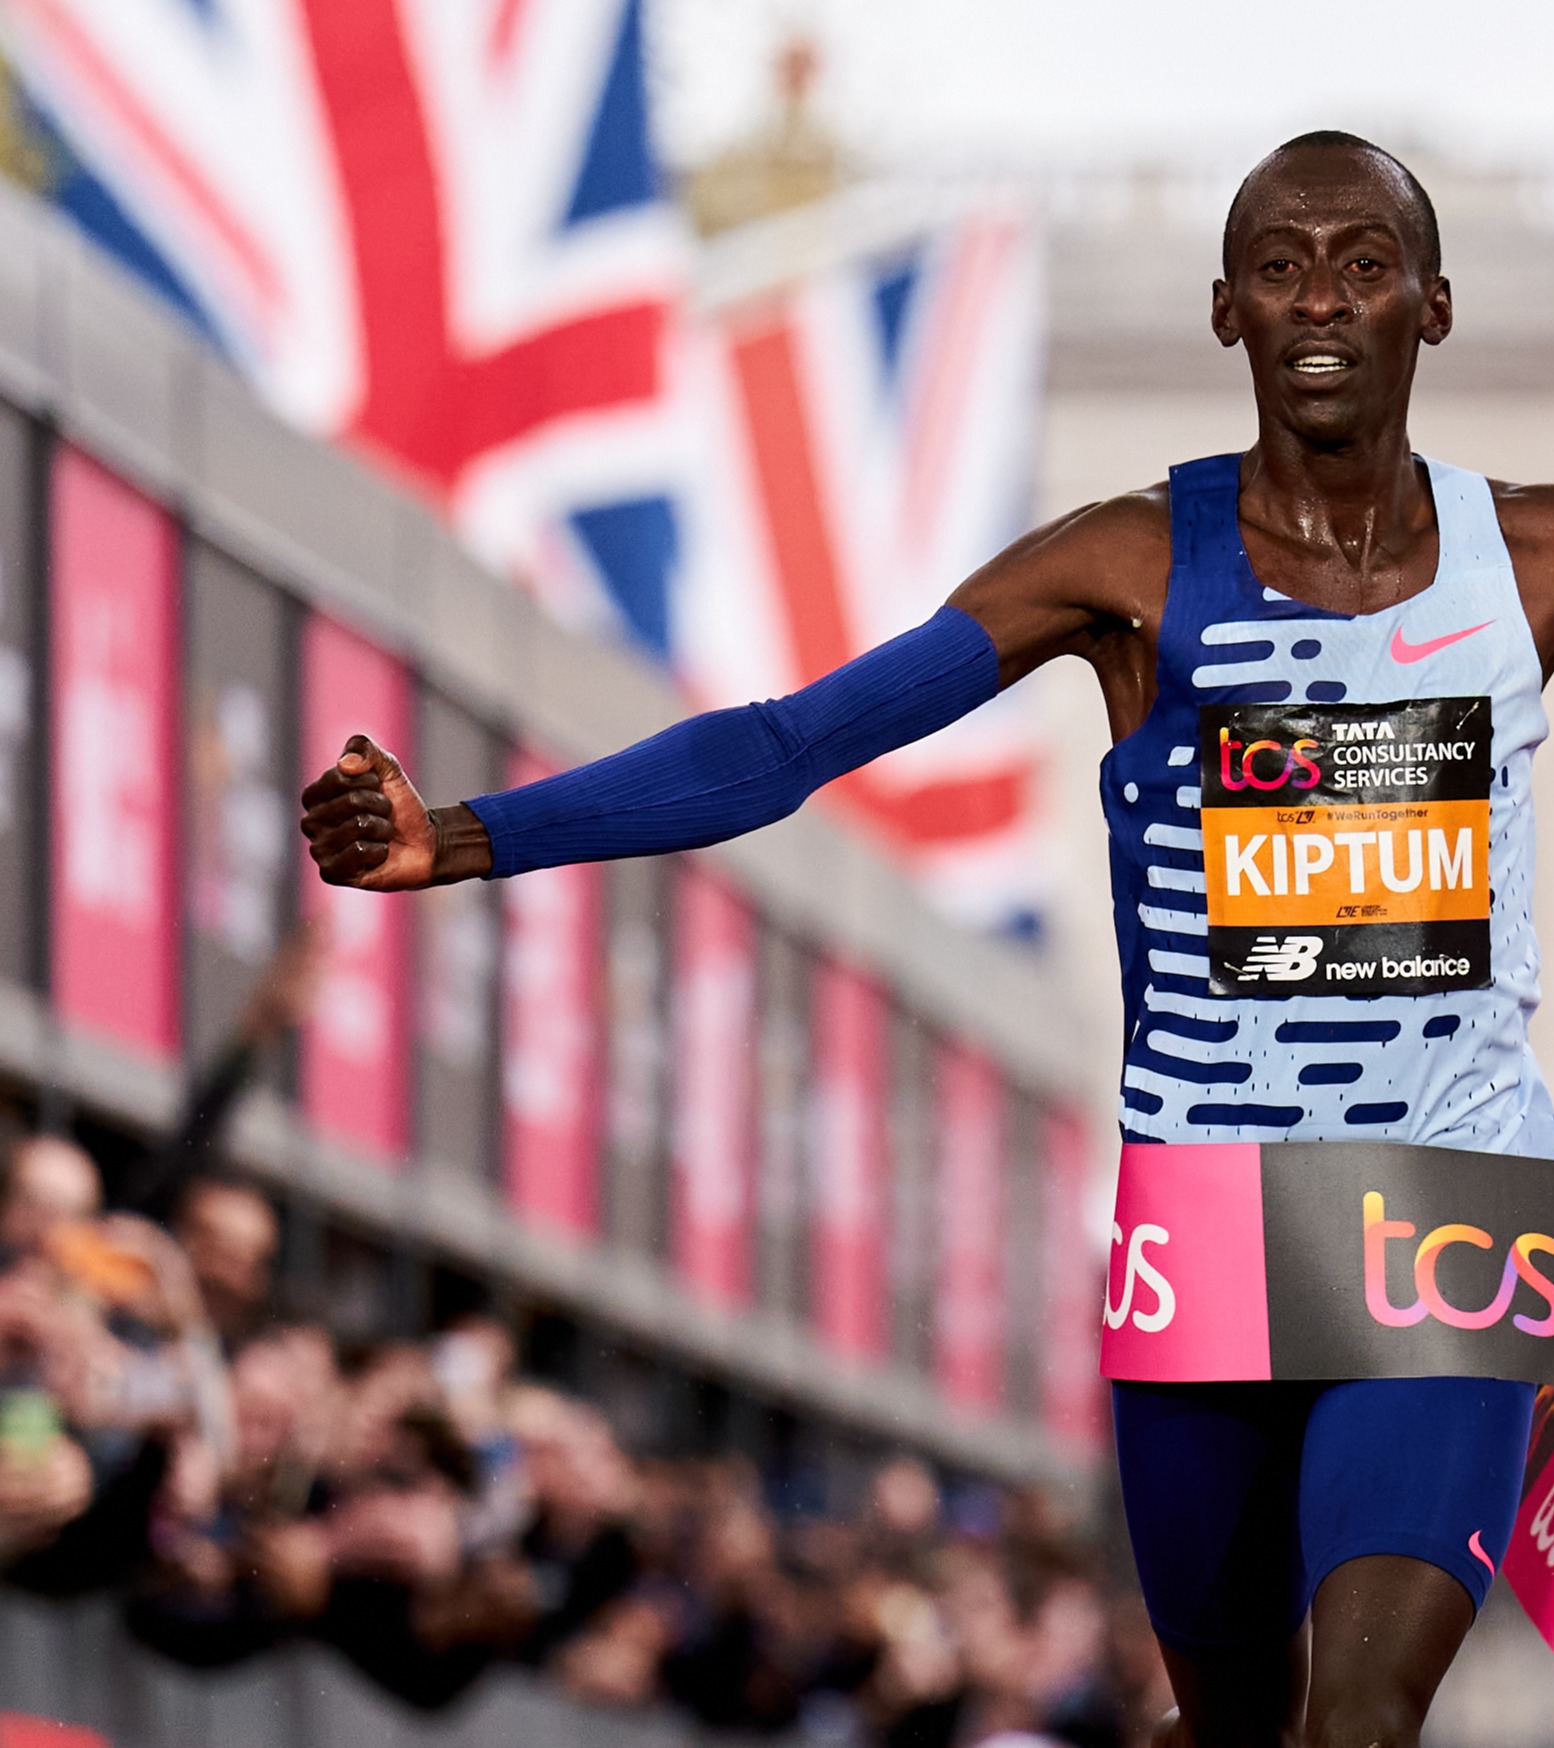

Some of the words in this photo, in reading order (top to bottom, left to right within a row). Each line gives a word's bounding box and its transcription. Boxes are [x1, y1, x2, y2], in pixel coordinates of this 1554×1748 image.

[1332, 722, 1395, 741] TATA
[1219, 727, 1321, 791] tcs
[1333, 742, 1476, 765] CONSULTANCY
[1334, 766, 1428, 788] SERVICES
[1327, 808, 1428, 821] #WeRunTogether
[1225, 827, 1473, 896] KIPTUM
[1326, 961, 1377, 980] new
[1382, 955, 1471, 978] balance
[1102, 1220, 1176, 1333] cs
